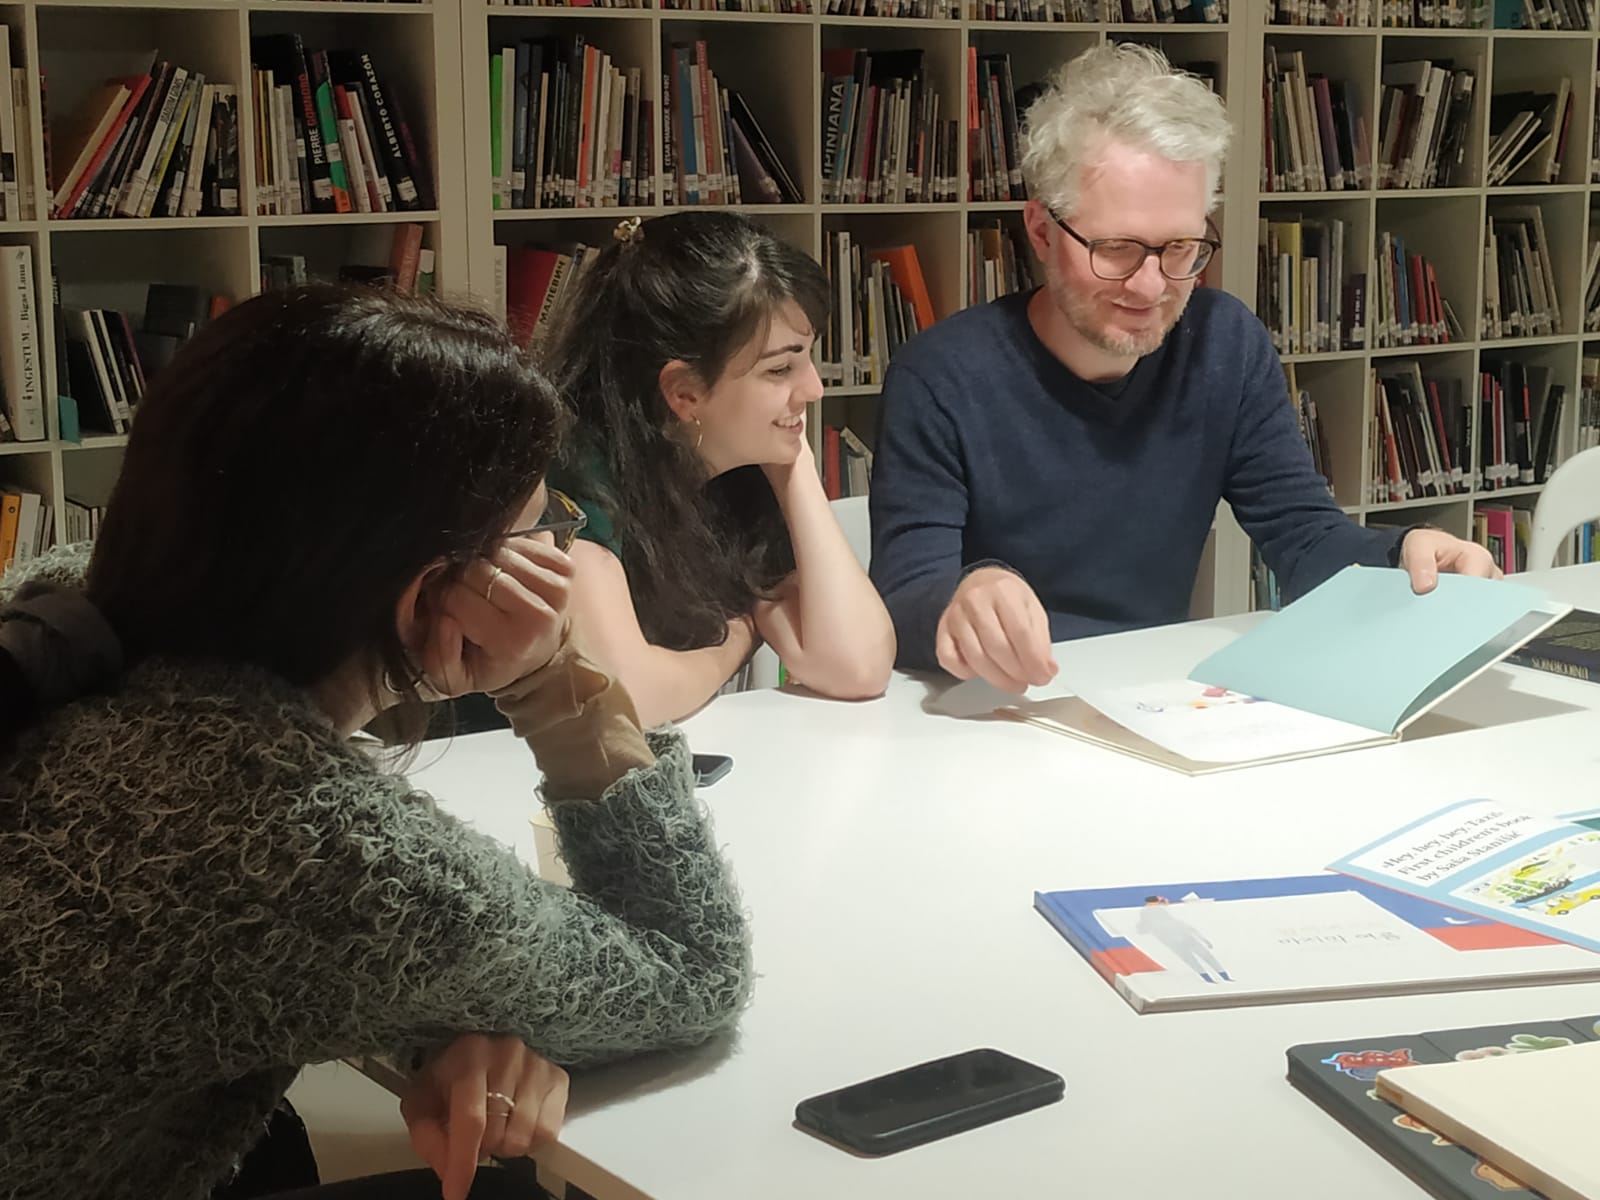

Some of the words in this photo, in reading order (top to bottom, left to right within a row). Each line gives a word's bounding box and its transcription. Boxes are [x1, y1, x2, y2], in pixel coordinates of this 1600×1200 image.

[361, 53, 384, 106] CORAZÓN
[308, 128, 324, 165] PIERRE
[379, 108, 402, 158] ALBERTO
[17, 264, 27, 290] Luna
[539, 260, 566, 323] МАЛЕВИЧ
[1398, 856, 1432, 875] First
[1416, 869, 1439, 882] by
